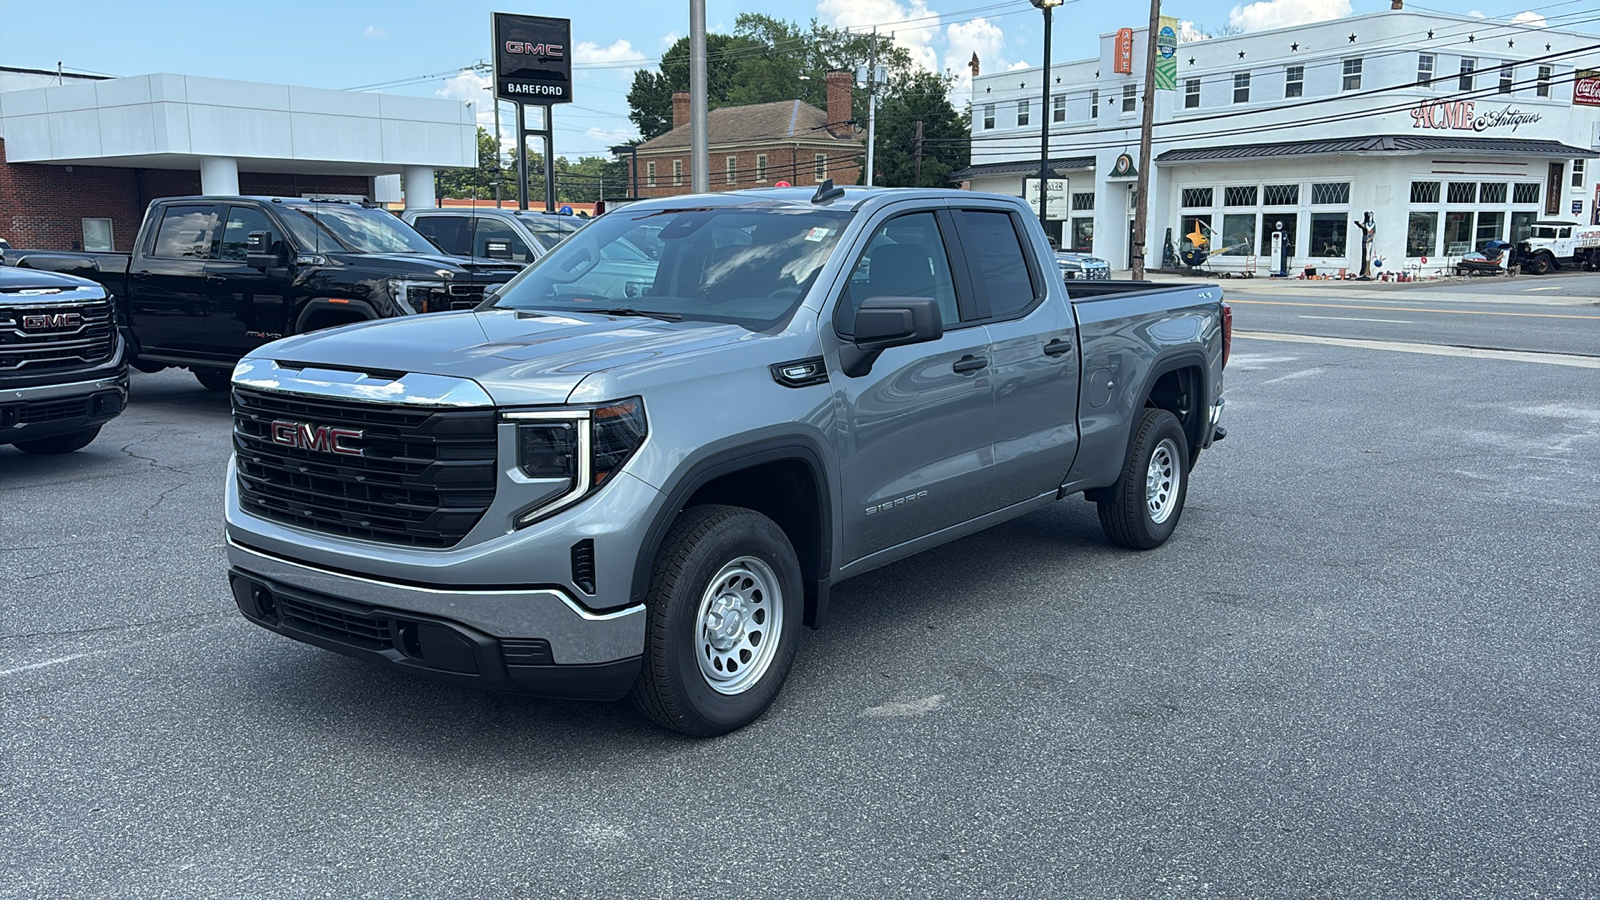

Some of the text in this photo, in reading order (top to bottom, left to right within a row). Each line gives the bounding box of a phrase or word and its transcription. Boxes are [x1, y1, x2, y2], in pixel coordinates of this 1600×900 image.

[505, 40, 563, 57] GMC
[1122, 31, 1130, 70] ACME
[507, 83, 563, 96] BAREFORD
[1410, 98, 1543, 133] ACME Antiques
[22, 312, 81, 329] GMC
[271, 419, 365, 458] GMC
[865, 489, 928, 516] SIERRA
